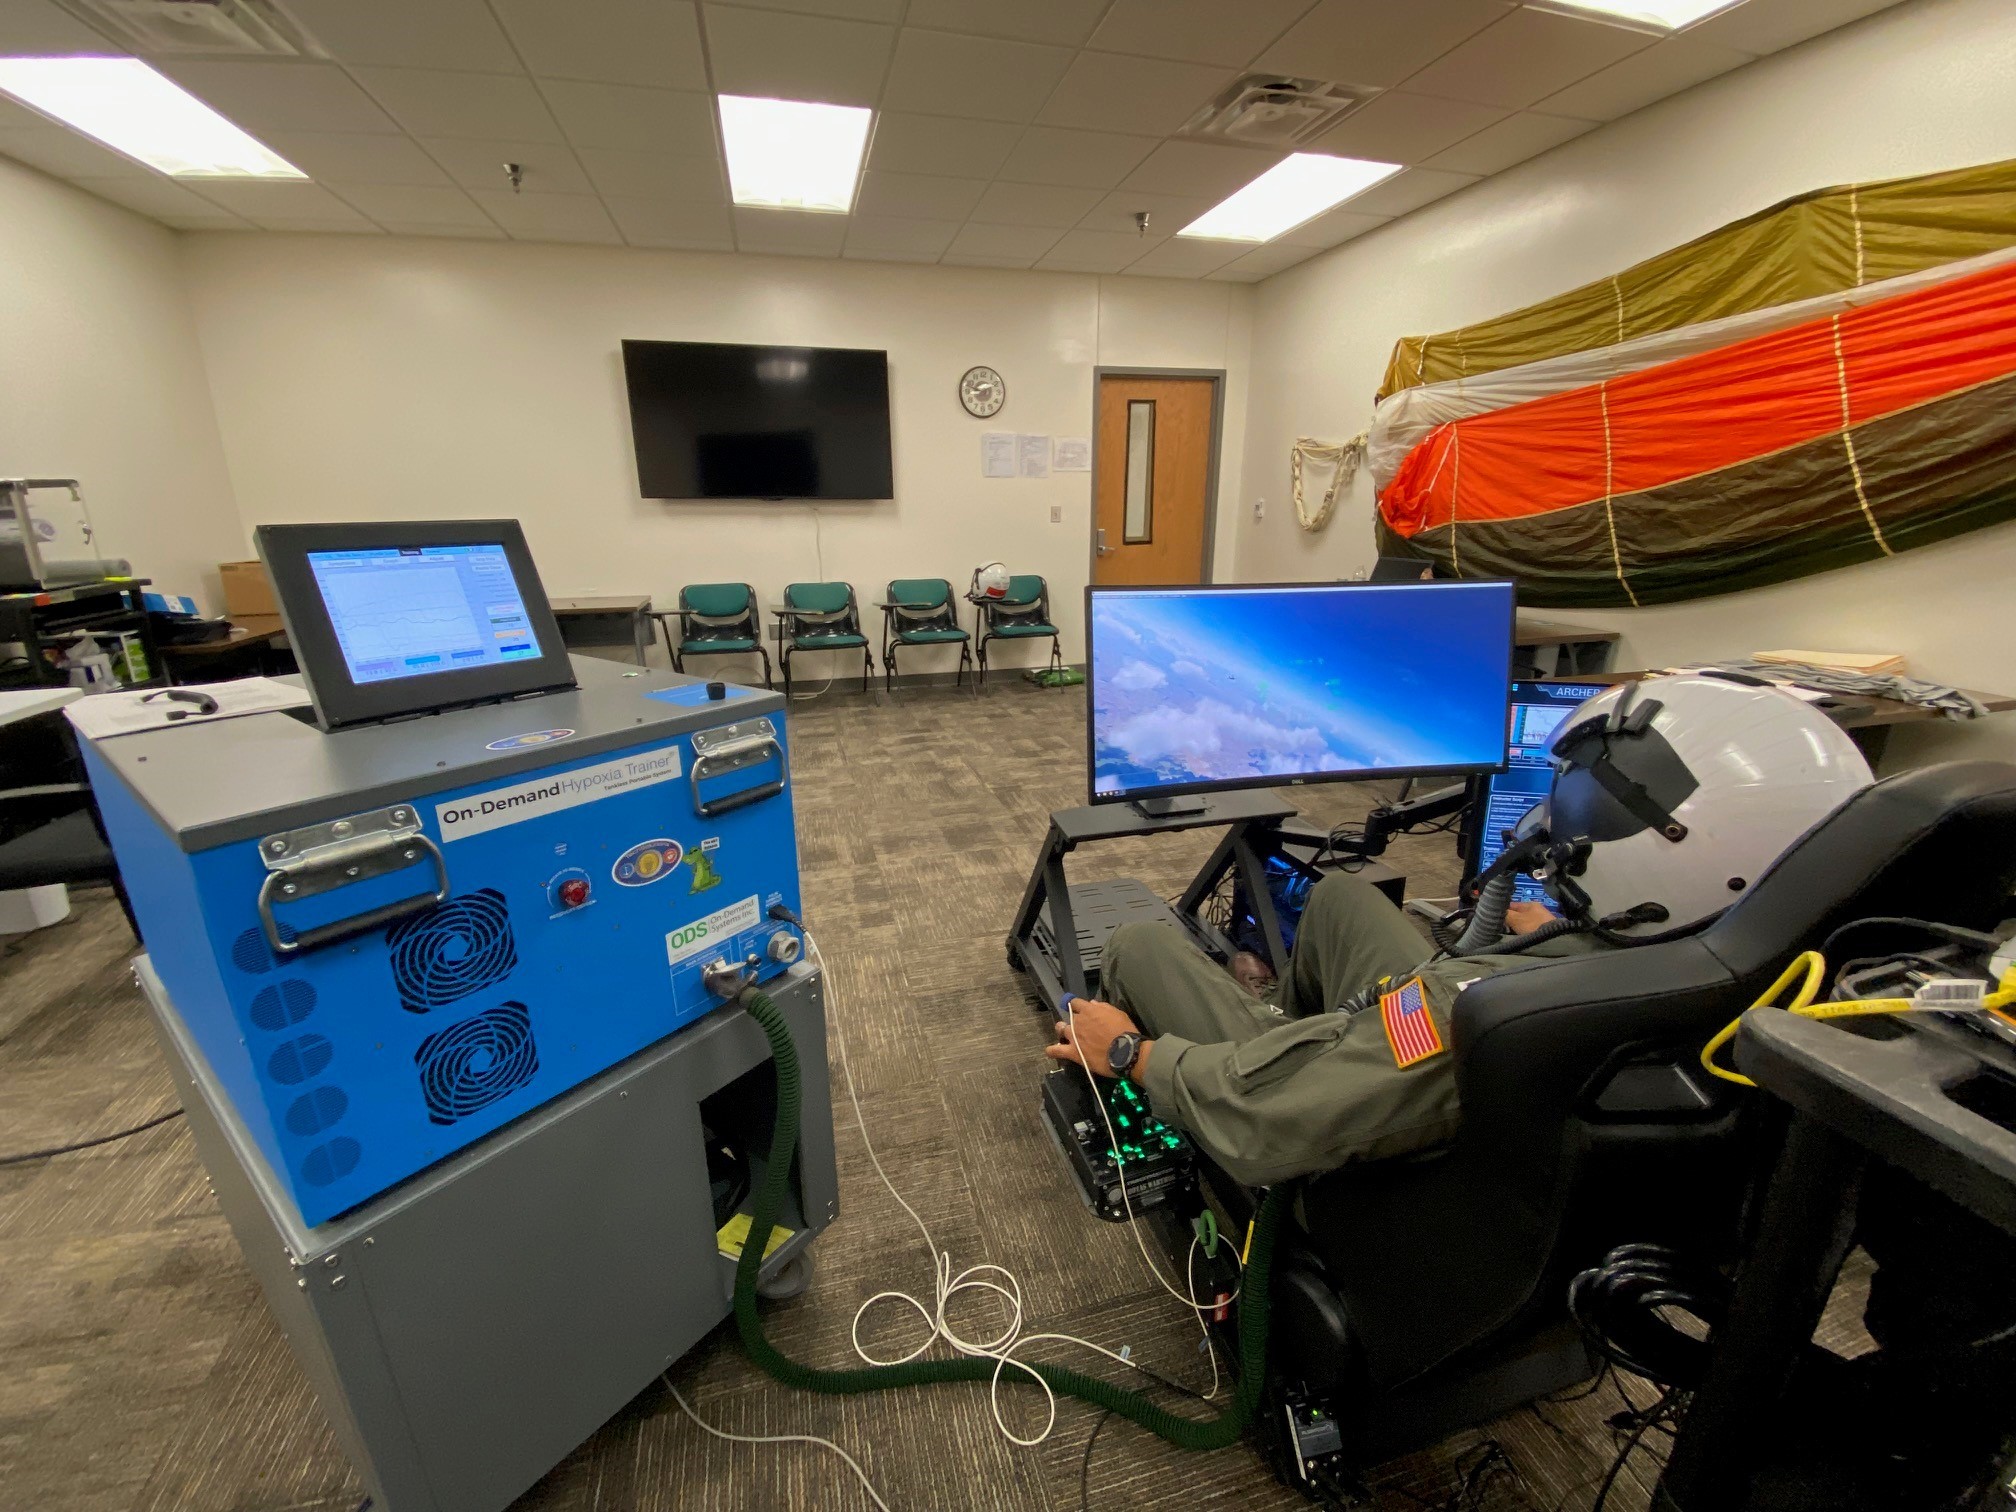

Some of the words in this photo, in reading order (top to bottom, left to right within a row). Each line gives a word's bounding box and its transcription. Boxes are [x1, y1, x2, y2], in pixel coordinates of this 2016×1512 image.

[442, 782, 561, 824] On-Demand
[562, 769, 622, 794] Hypoxia
[604, 780, 628, 791] Tankless
[628, 773, 652, 785] Portable
[652, 768, 672, 779] System
[671, 921, 708, 949] ODS
[709, 899, 755, 924] On-Demand
[711, 914, 741, 933] Systems
[741, 910, 755, 919] Inc.
